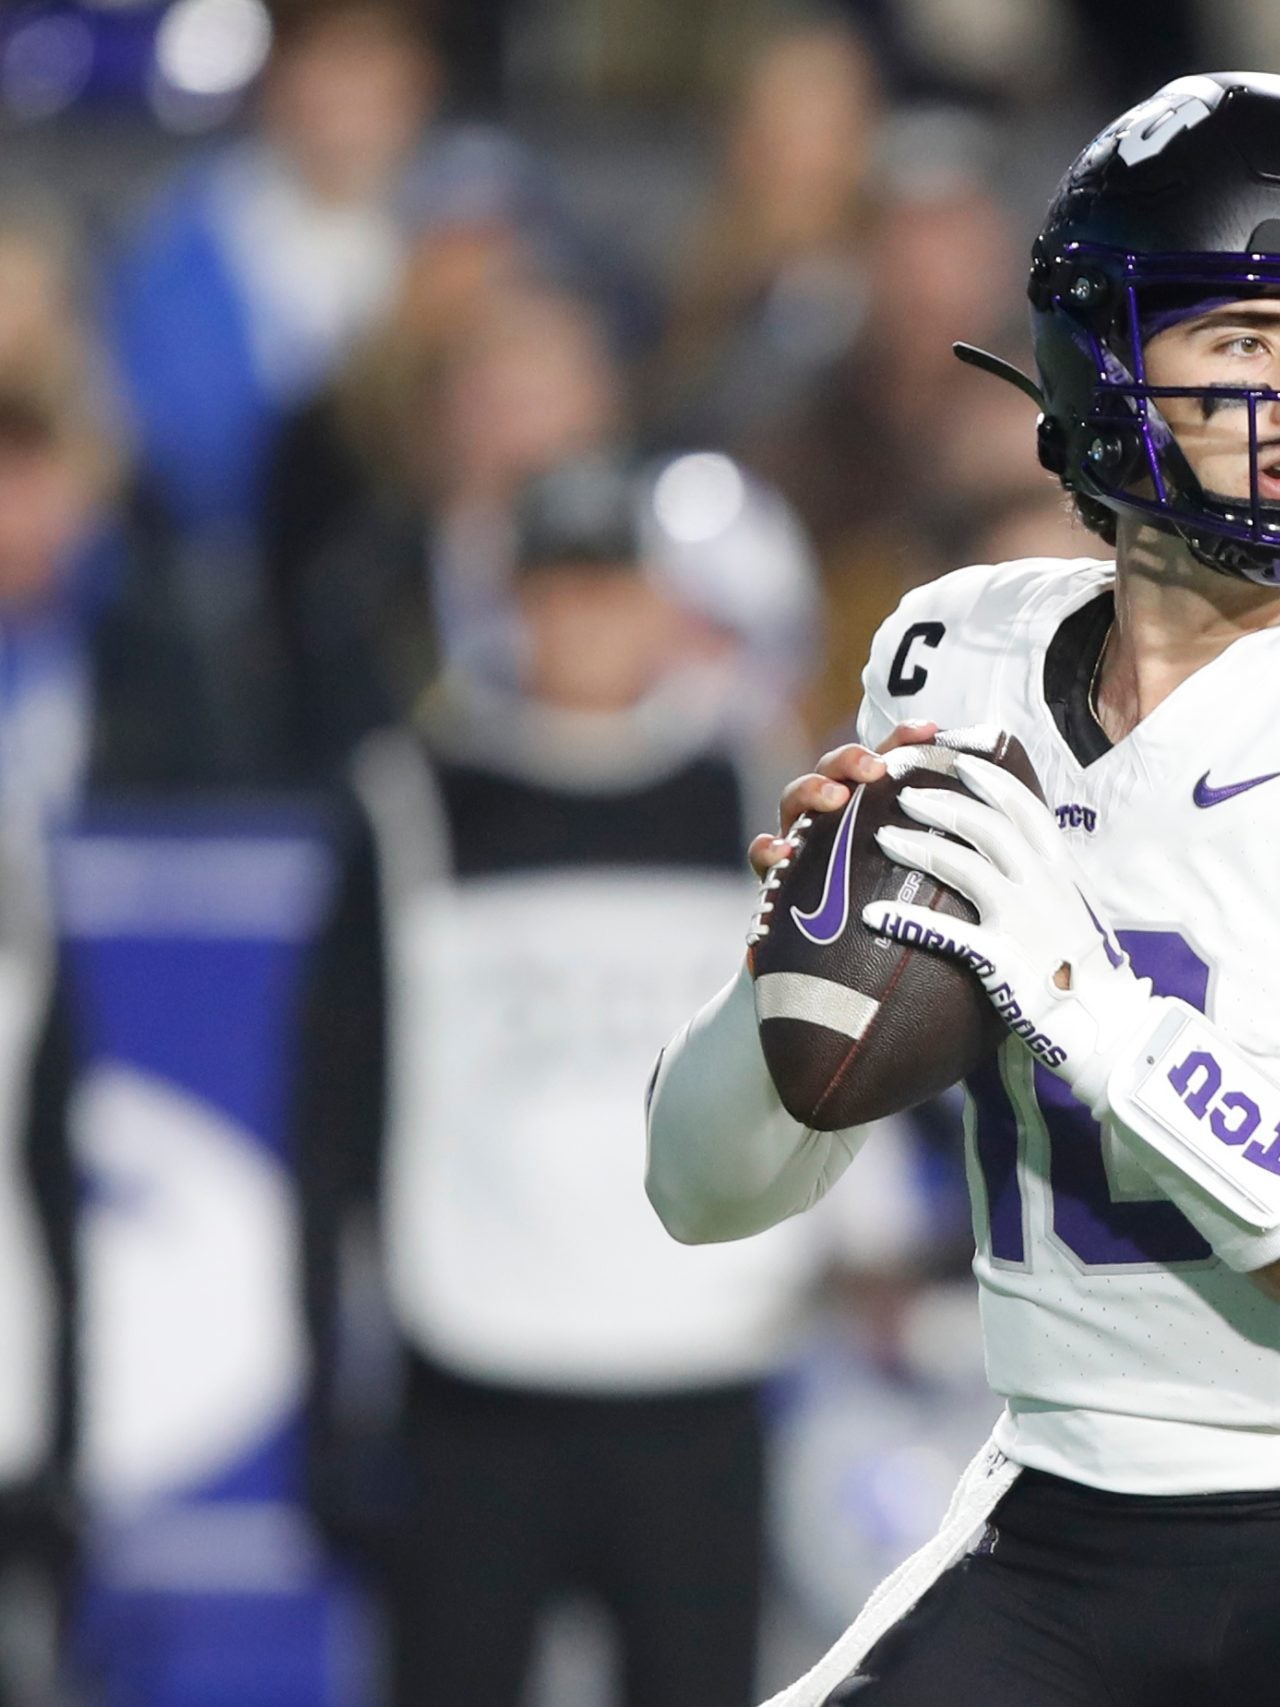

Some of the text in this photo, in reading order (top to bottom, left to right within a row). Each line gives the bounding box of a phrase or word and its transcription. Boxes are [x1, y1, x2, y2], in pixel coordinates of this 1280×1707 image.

[887, 621, 946, 697] C
[1054, 803, 1097, 833] TCU
[881, 913, 1068, 1069] HORNED FROGS
